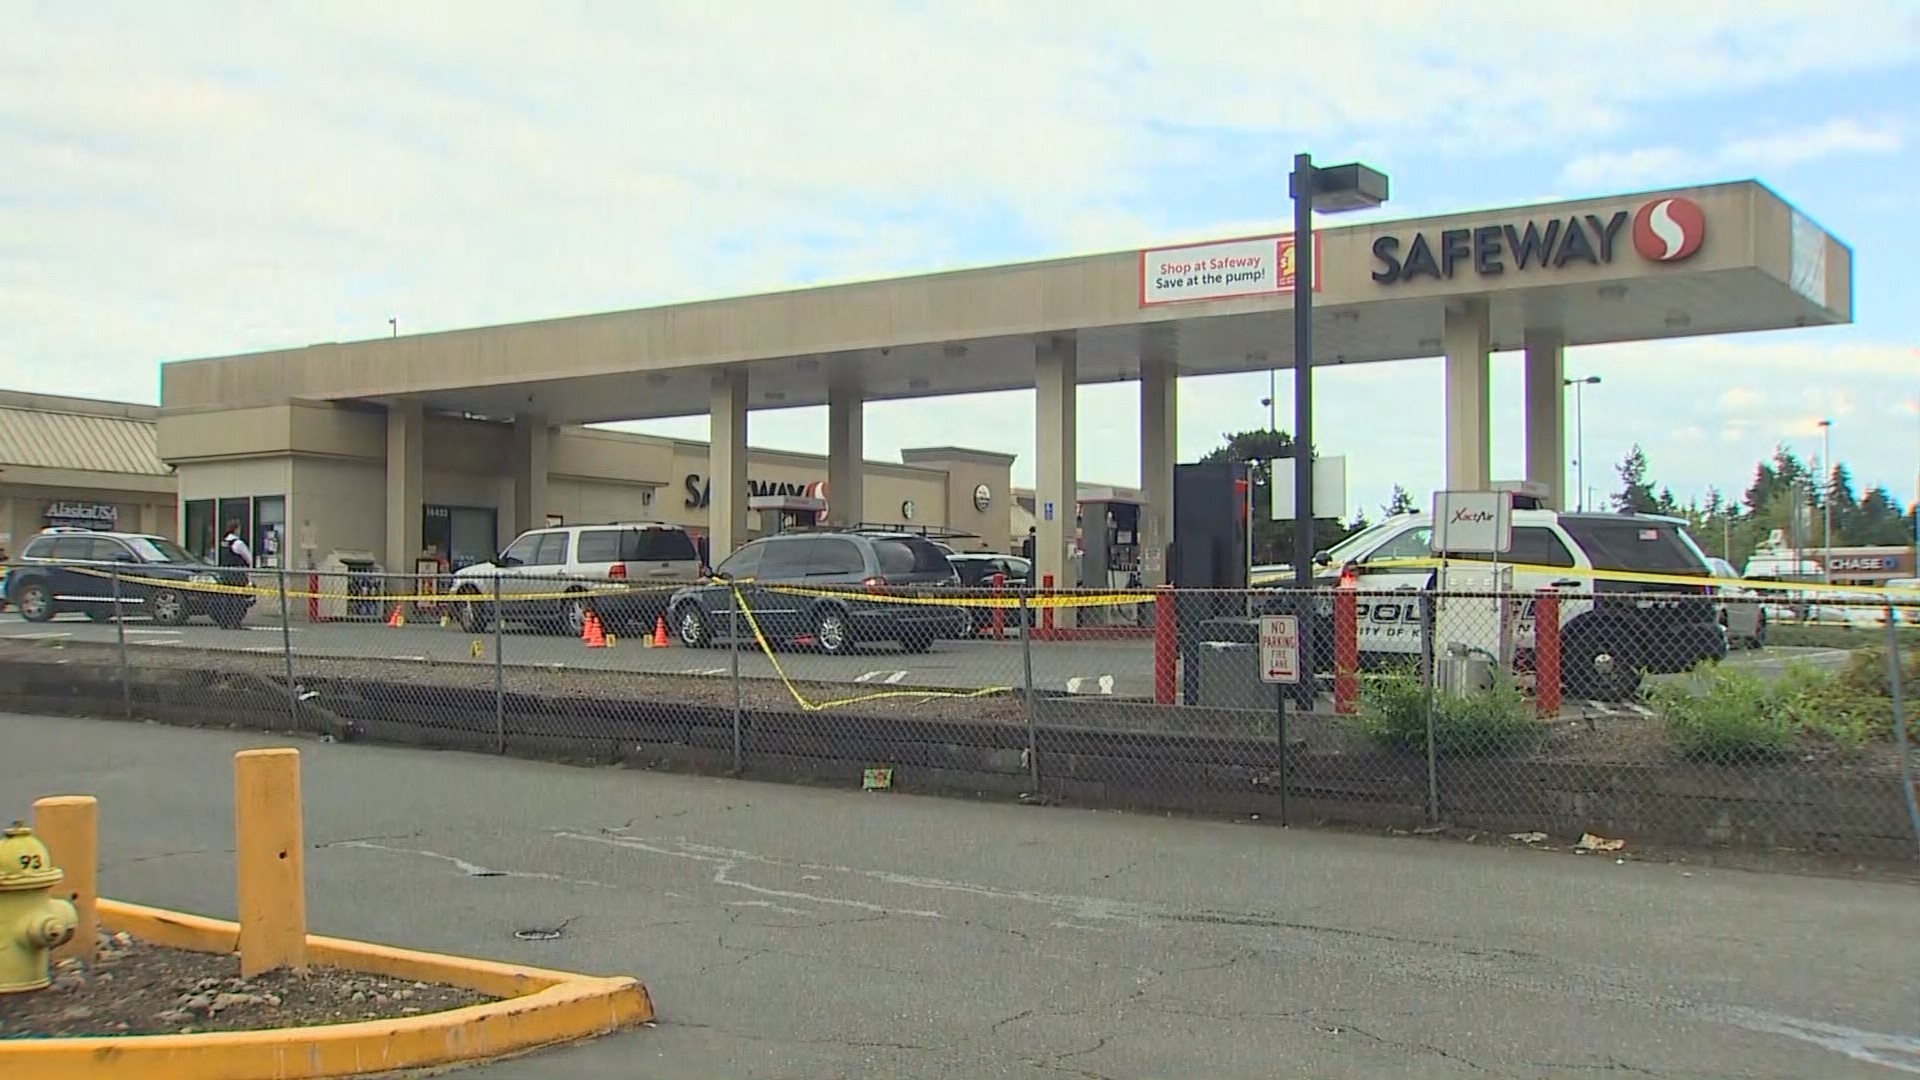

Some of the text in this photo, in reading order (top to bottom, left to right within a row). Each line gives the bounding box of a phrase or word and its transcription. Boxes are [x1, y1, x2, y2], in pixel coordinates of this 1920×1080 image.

[1372, 211, 1628, 284] SAFEWAY
[1160, 256, 1261, 276] Shop at Safeway
[1156, 277, 1183, 289] Save
[1186, 275, 1198, 287] at
[1202, 272, 1222, 285] the
[1225, 268, 1265, 285] pump!
[1829, 558, 1883, 571] CHASE
[1271, 621, 1286, 634] NO
[1262, 635, 1295, 649] PARKING
[19, 854, 42, 870] 93
